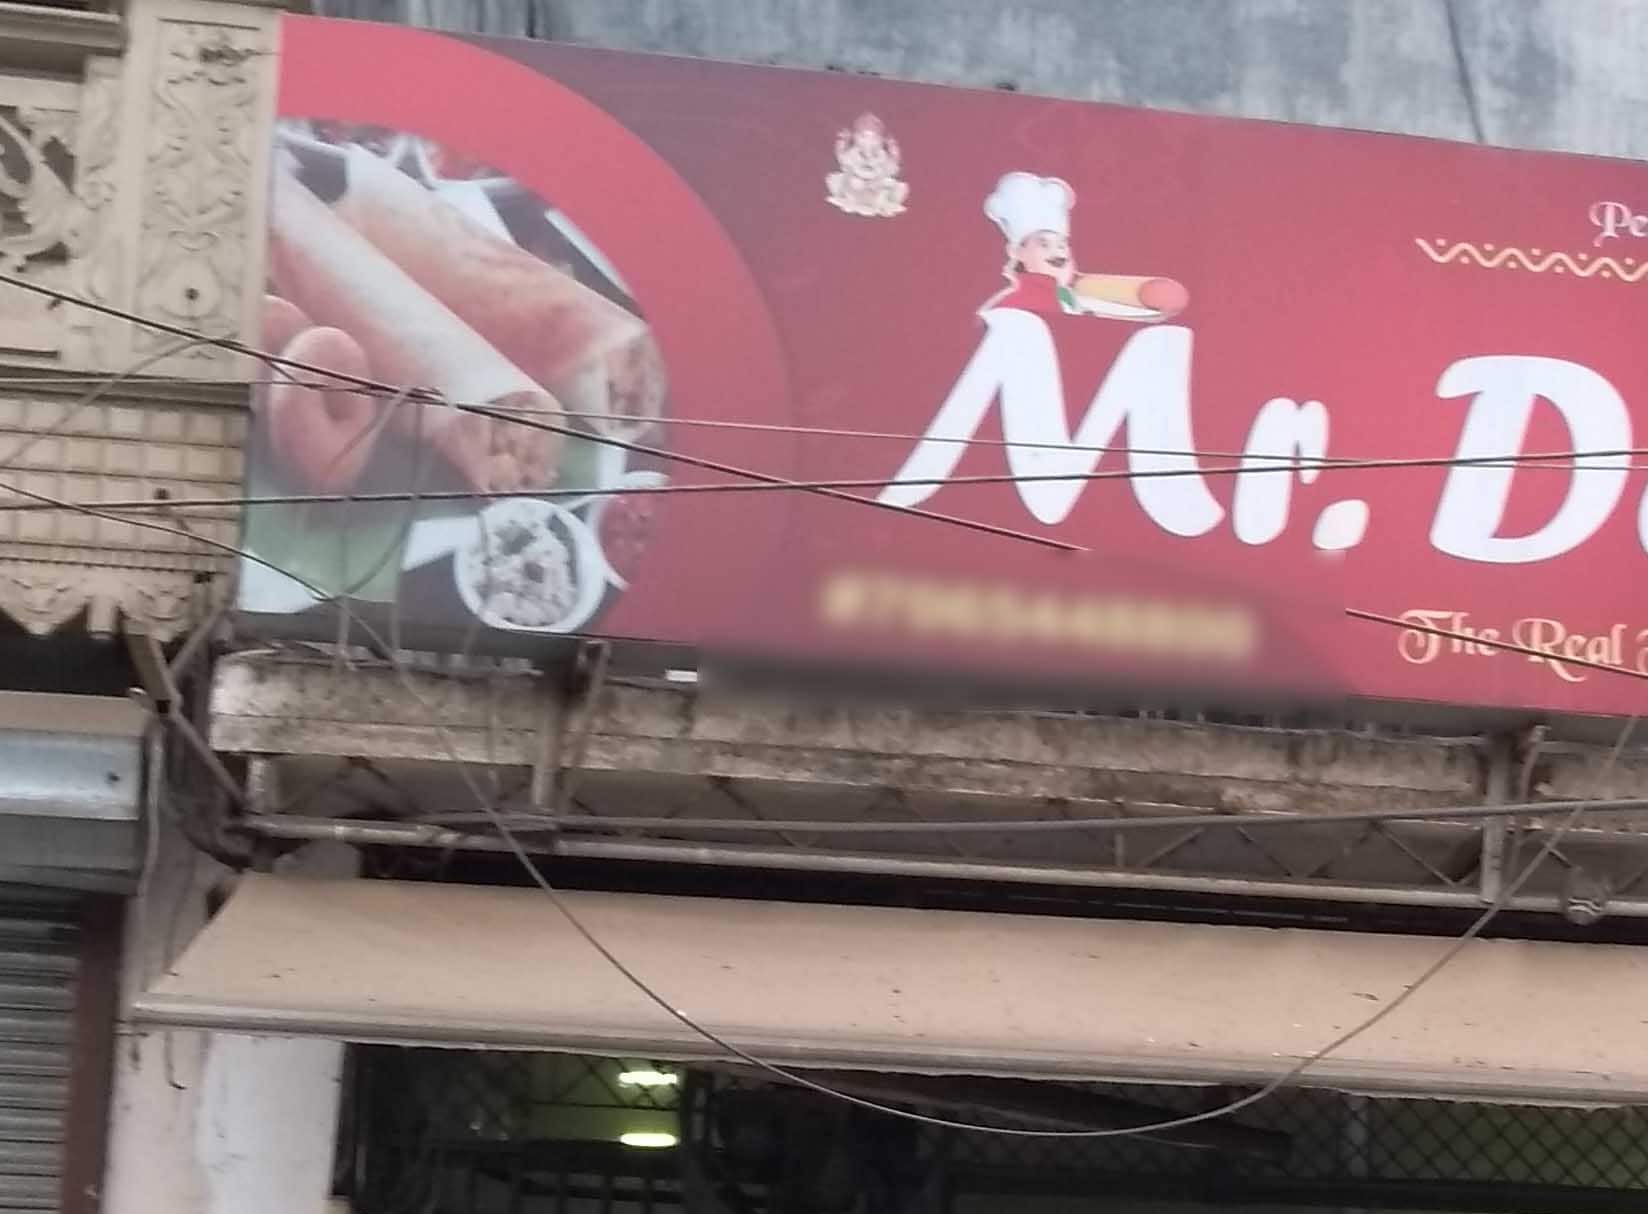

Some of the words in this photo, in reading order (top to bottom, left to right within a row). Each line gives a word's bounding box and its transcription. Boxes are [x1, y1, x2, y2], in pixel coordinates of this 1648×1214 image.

[876, 307, 1369, 551] Mr.
[1397, 609, 1501, 665] The
[1512, 617, 1627, 682] Real
